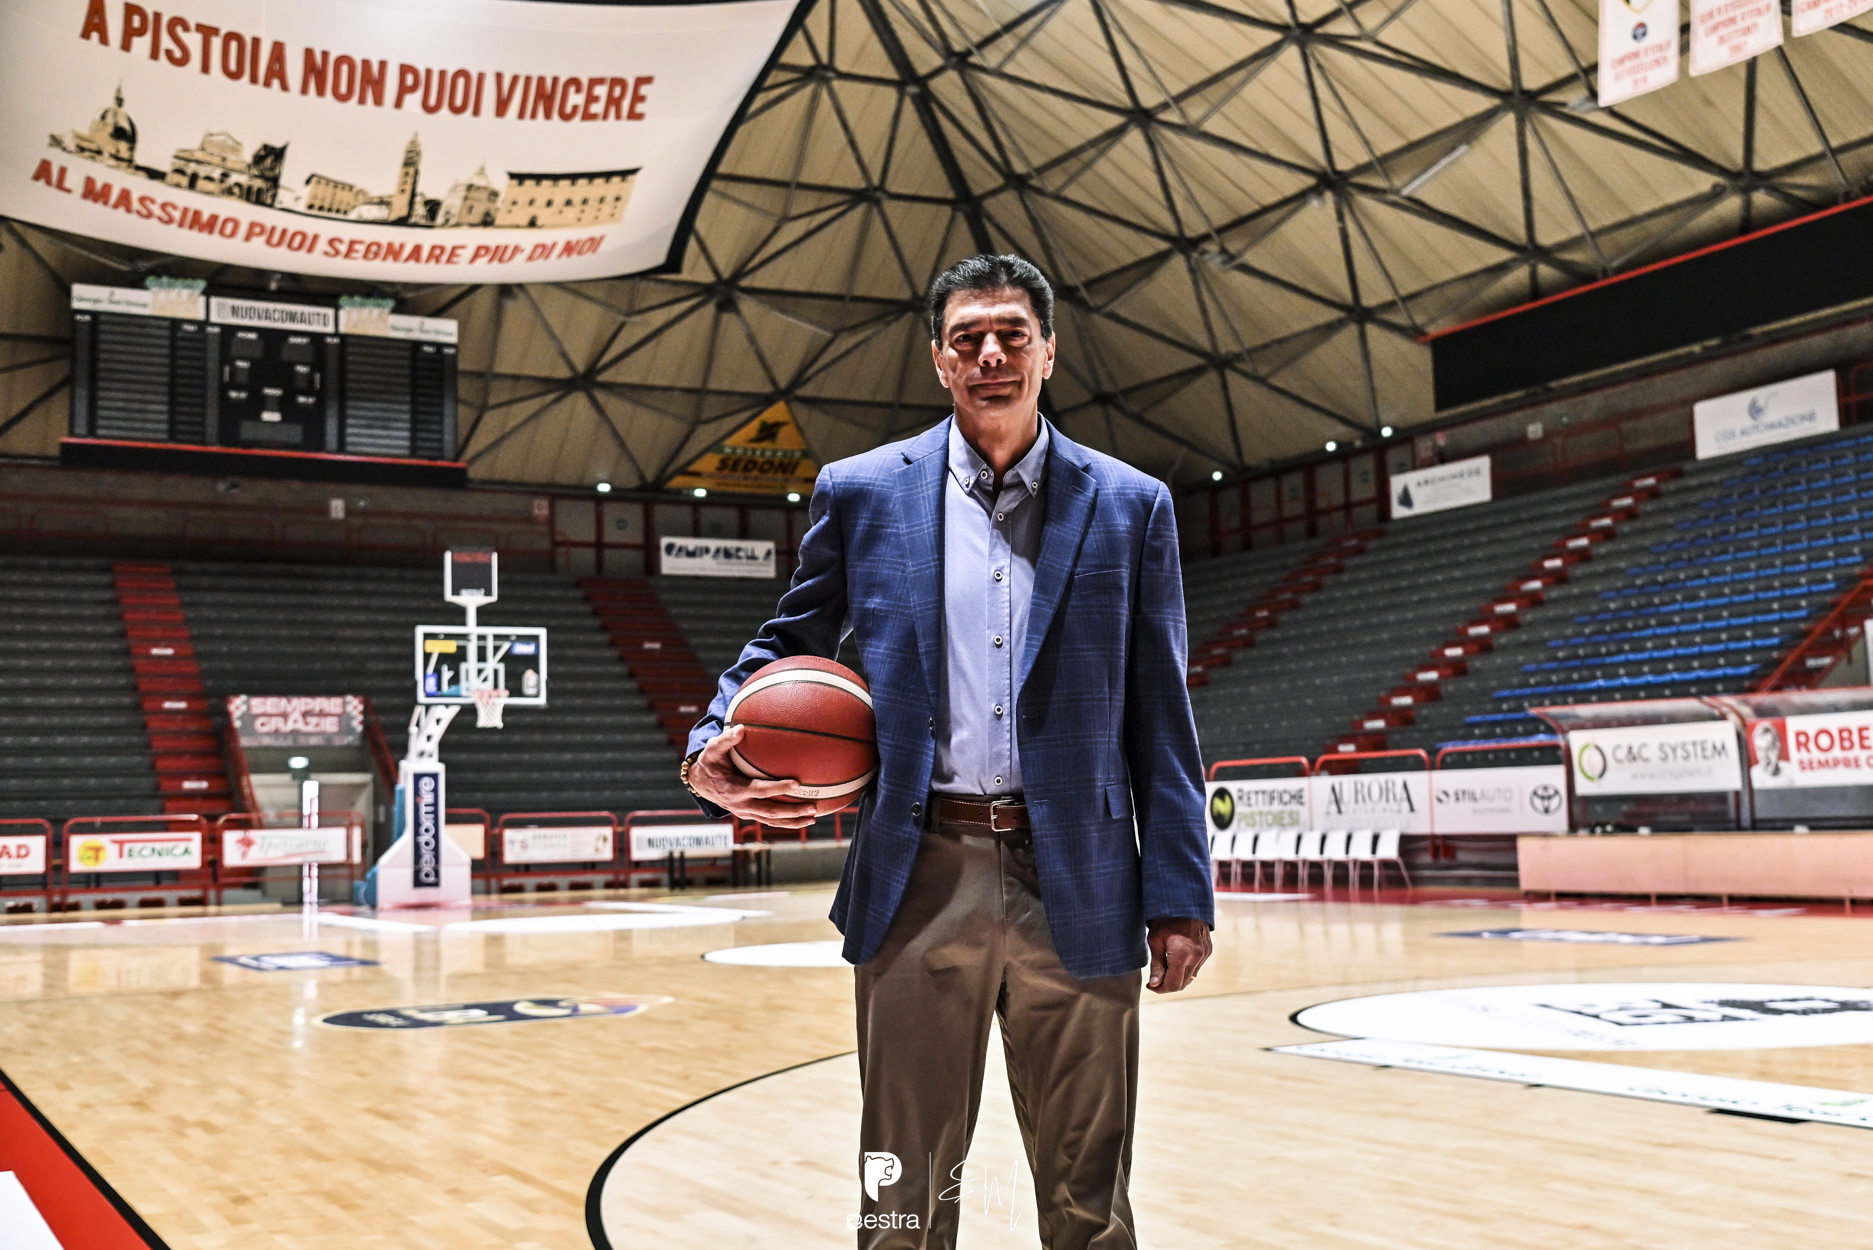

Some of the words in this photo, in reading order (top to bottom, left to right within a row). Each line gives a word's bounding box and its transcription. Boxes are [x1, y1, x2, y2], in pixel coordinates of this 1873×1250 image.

[80, 0, 110, 46] A
[119, 1, 291, 92] PISTOIA
[301, 47, 388, 107] NON
[394, 62, 487, 118] PUOI
[494, 71, 655, 122] VINCERE
[31, 157, 73, 193] AL
[82, 175, 240, 240] MASSIMO
[243, 221, 320, 255] PUOI
[323, 237, 465, 266] SEGNARE
[525, 240, 558, 263] DI
[556, 234, 607, 261] NOI
[716, 456, 801, 476] SEDONI
[249, 696, 344, 715] SEMPRE
[254, 710, 340, 733] GRAZIE
[1611, 743, 1651, 764] C&C
[1658, 739, 1729, 763] SYSTEM
[1794, 726, 1873, 754] ROBE
[1797, 754, 1862, 773] SEMPRE
[1236, 787, 1305, 807] RETTIFICHE
[1325, 777, 1416, 815] AURORA
[416, 775, 438, 884] perdormire
[1236, 811, 1300, 827] PISTOIESI
[110, 838, 193, 860] TECNICA
